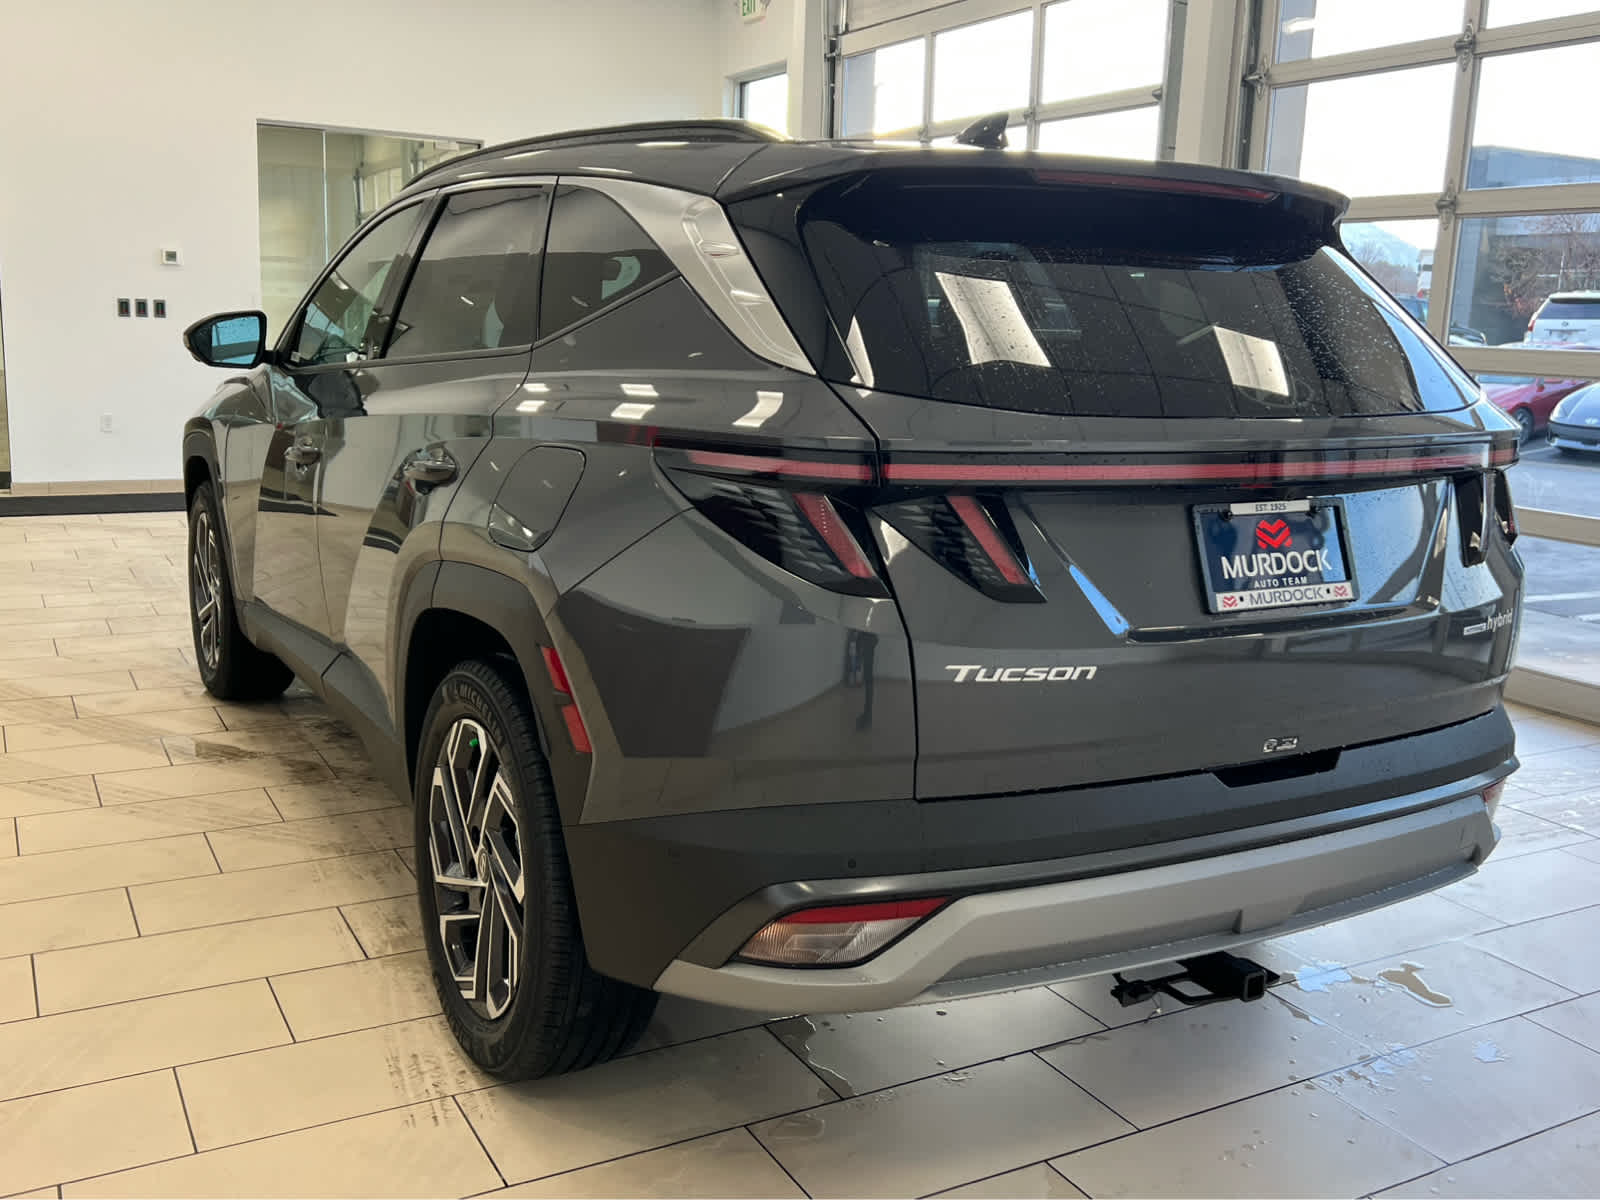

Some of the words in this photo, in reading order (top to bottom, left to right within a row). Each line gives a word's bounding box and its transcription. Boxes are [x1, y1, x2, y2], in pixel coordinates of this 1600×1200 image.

[1221, 549, 1332, 579] MURDOCK
[1253, 579, 1280, 589] AUTO
[1283, 576, 1308, 586] TEAM
[1250, 587, 1324, 606] MURDOCK
[1487, 608, 1513, 632] hybrid
